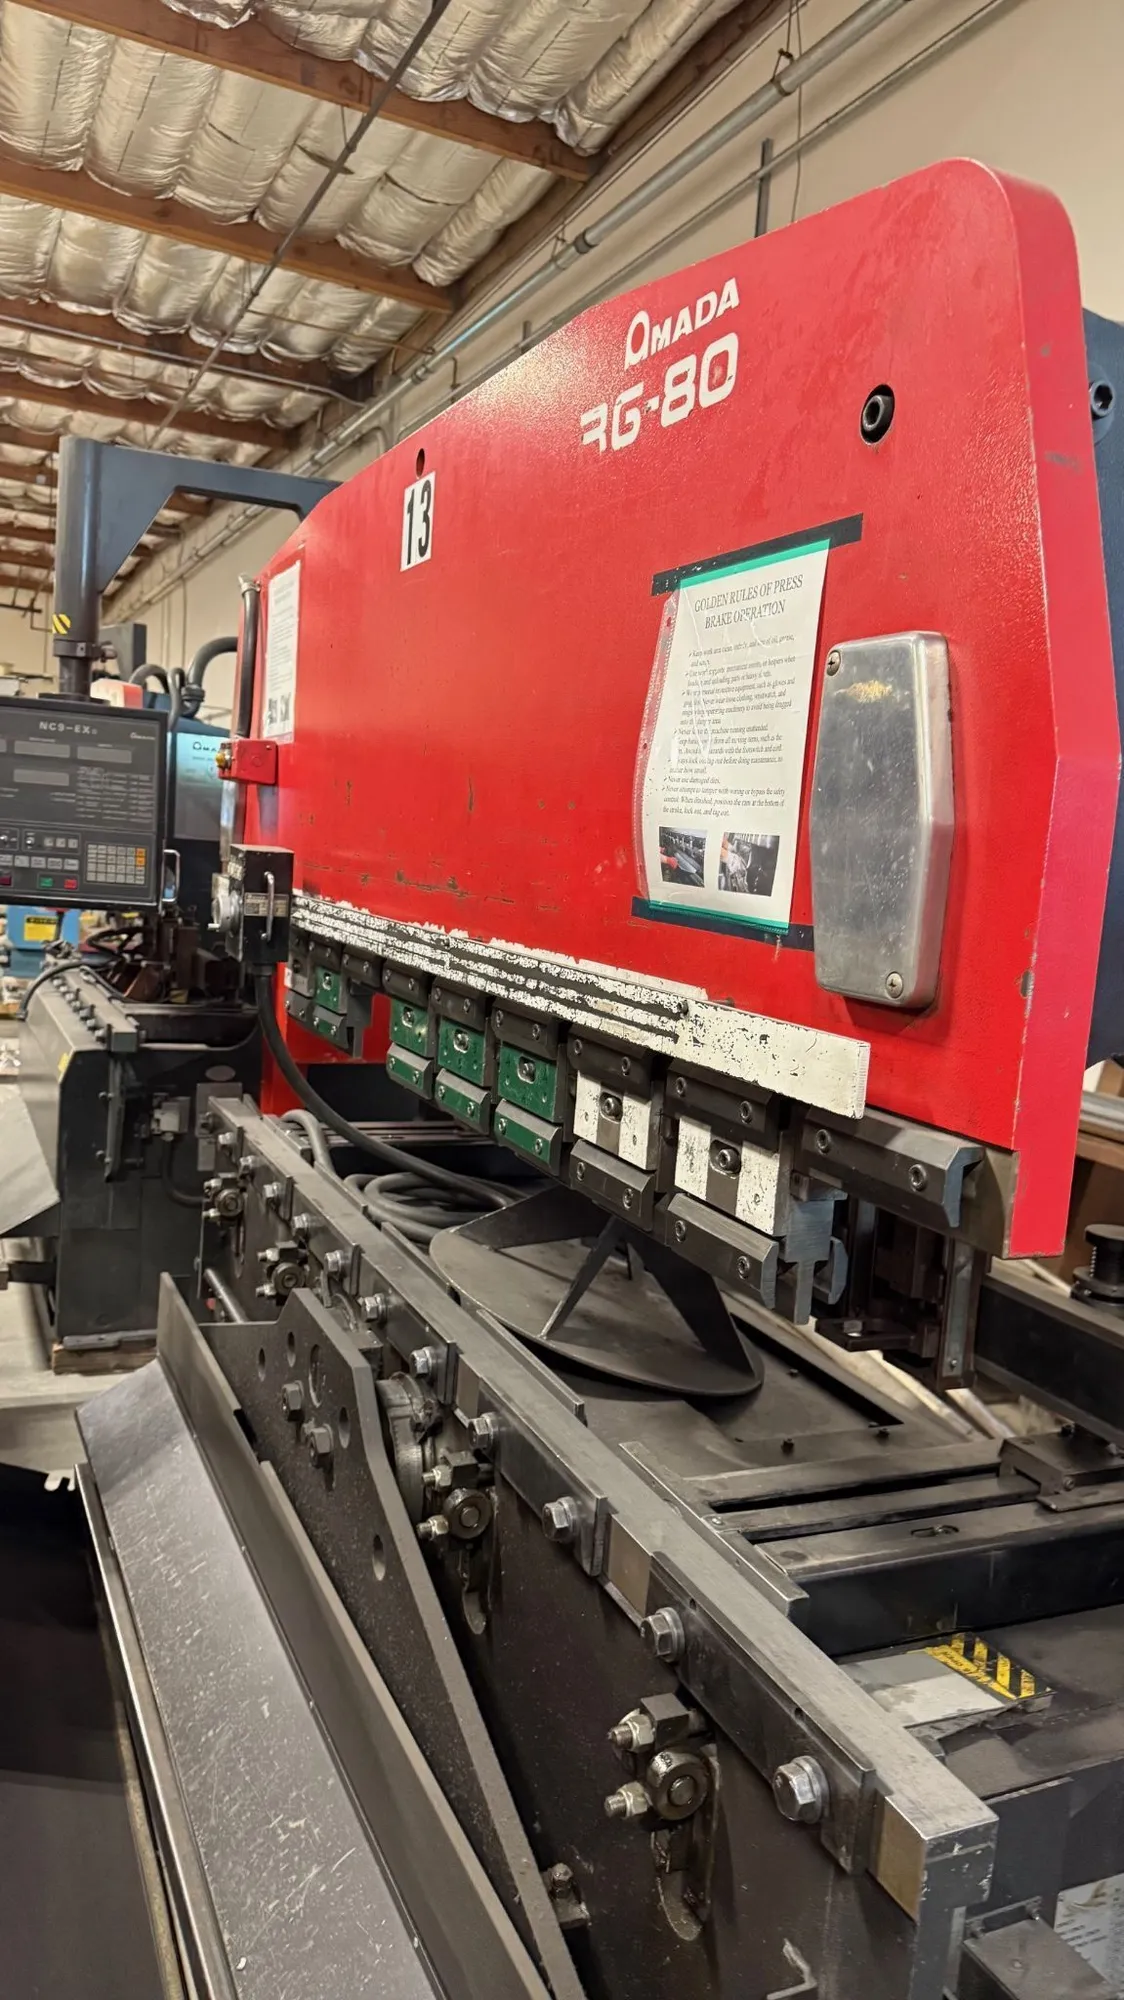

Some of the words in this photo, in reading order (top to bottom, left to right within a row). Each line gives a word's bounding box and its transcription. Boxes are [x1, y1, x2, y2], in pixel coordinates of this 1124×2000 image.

[624, 277, 740, 370] AMADA
[580, 332, 739, 455] RG-80
[407, 480, 431, 565] 13
[694, 592, 729, 612] GOLDEN
[729, 585, 759, 604] RULES
[759, 581, 773, 597] OF
[774, 574, 804, 594] PRESS
[705, 611, 733, 629] BRAKE
[733, 599, 786, 623] OPERATION
